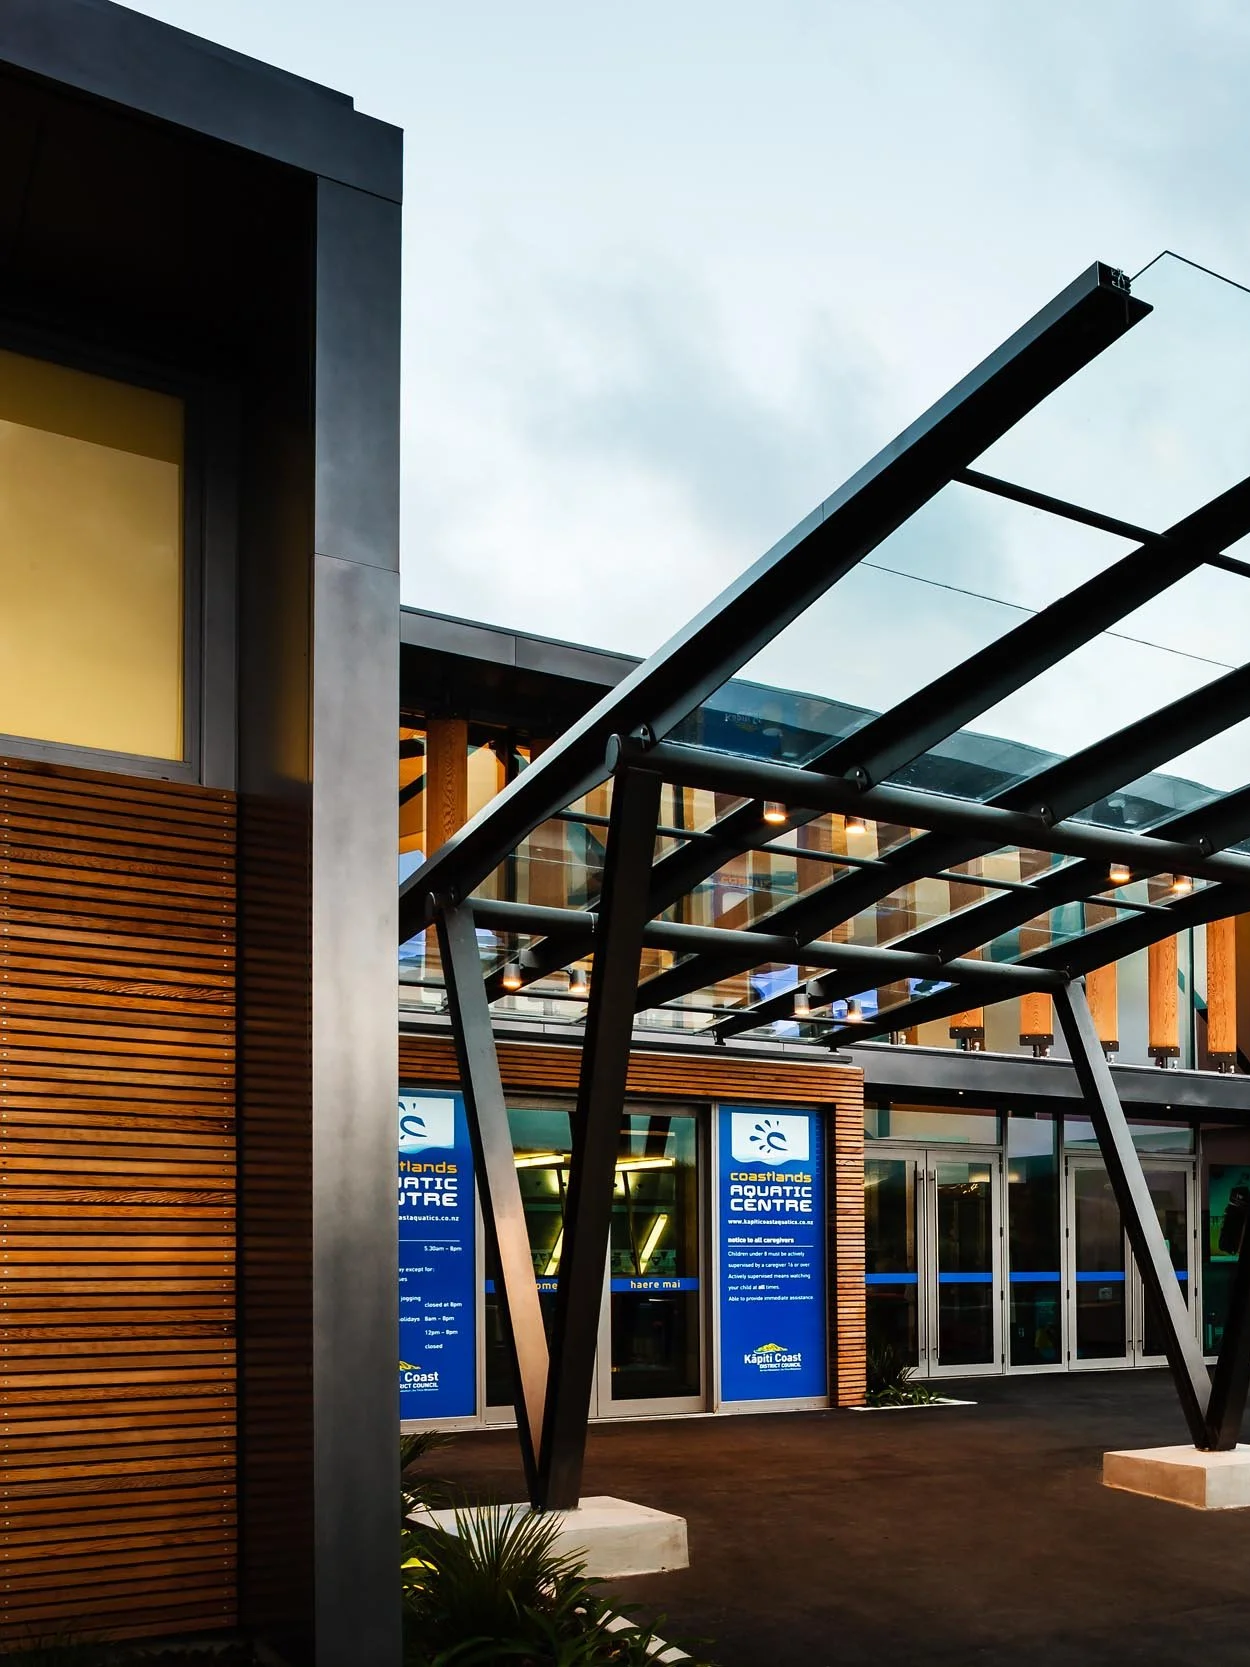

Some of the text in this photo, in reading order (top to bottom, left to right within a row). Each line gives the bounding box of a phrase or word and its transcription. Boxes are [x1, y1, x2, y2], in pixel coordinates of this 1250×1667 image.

[400, 1160, 458, 1174] tlands
[398, 1176, 458, 1190] ATIC
[730, 1171, 812, 1182] coastlands
[730, 1185, 812, 1198] AQUATIC
[398, 1192, 458, 1207] TRE
[730, 1198, 812, 1212] CENTRE
[630, 1280, 681, 1289] haere mai
[744, 1352, 802, 1365] Kāpiti Coast
[404, 1371, 439, 1382] Coast
